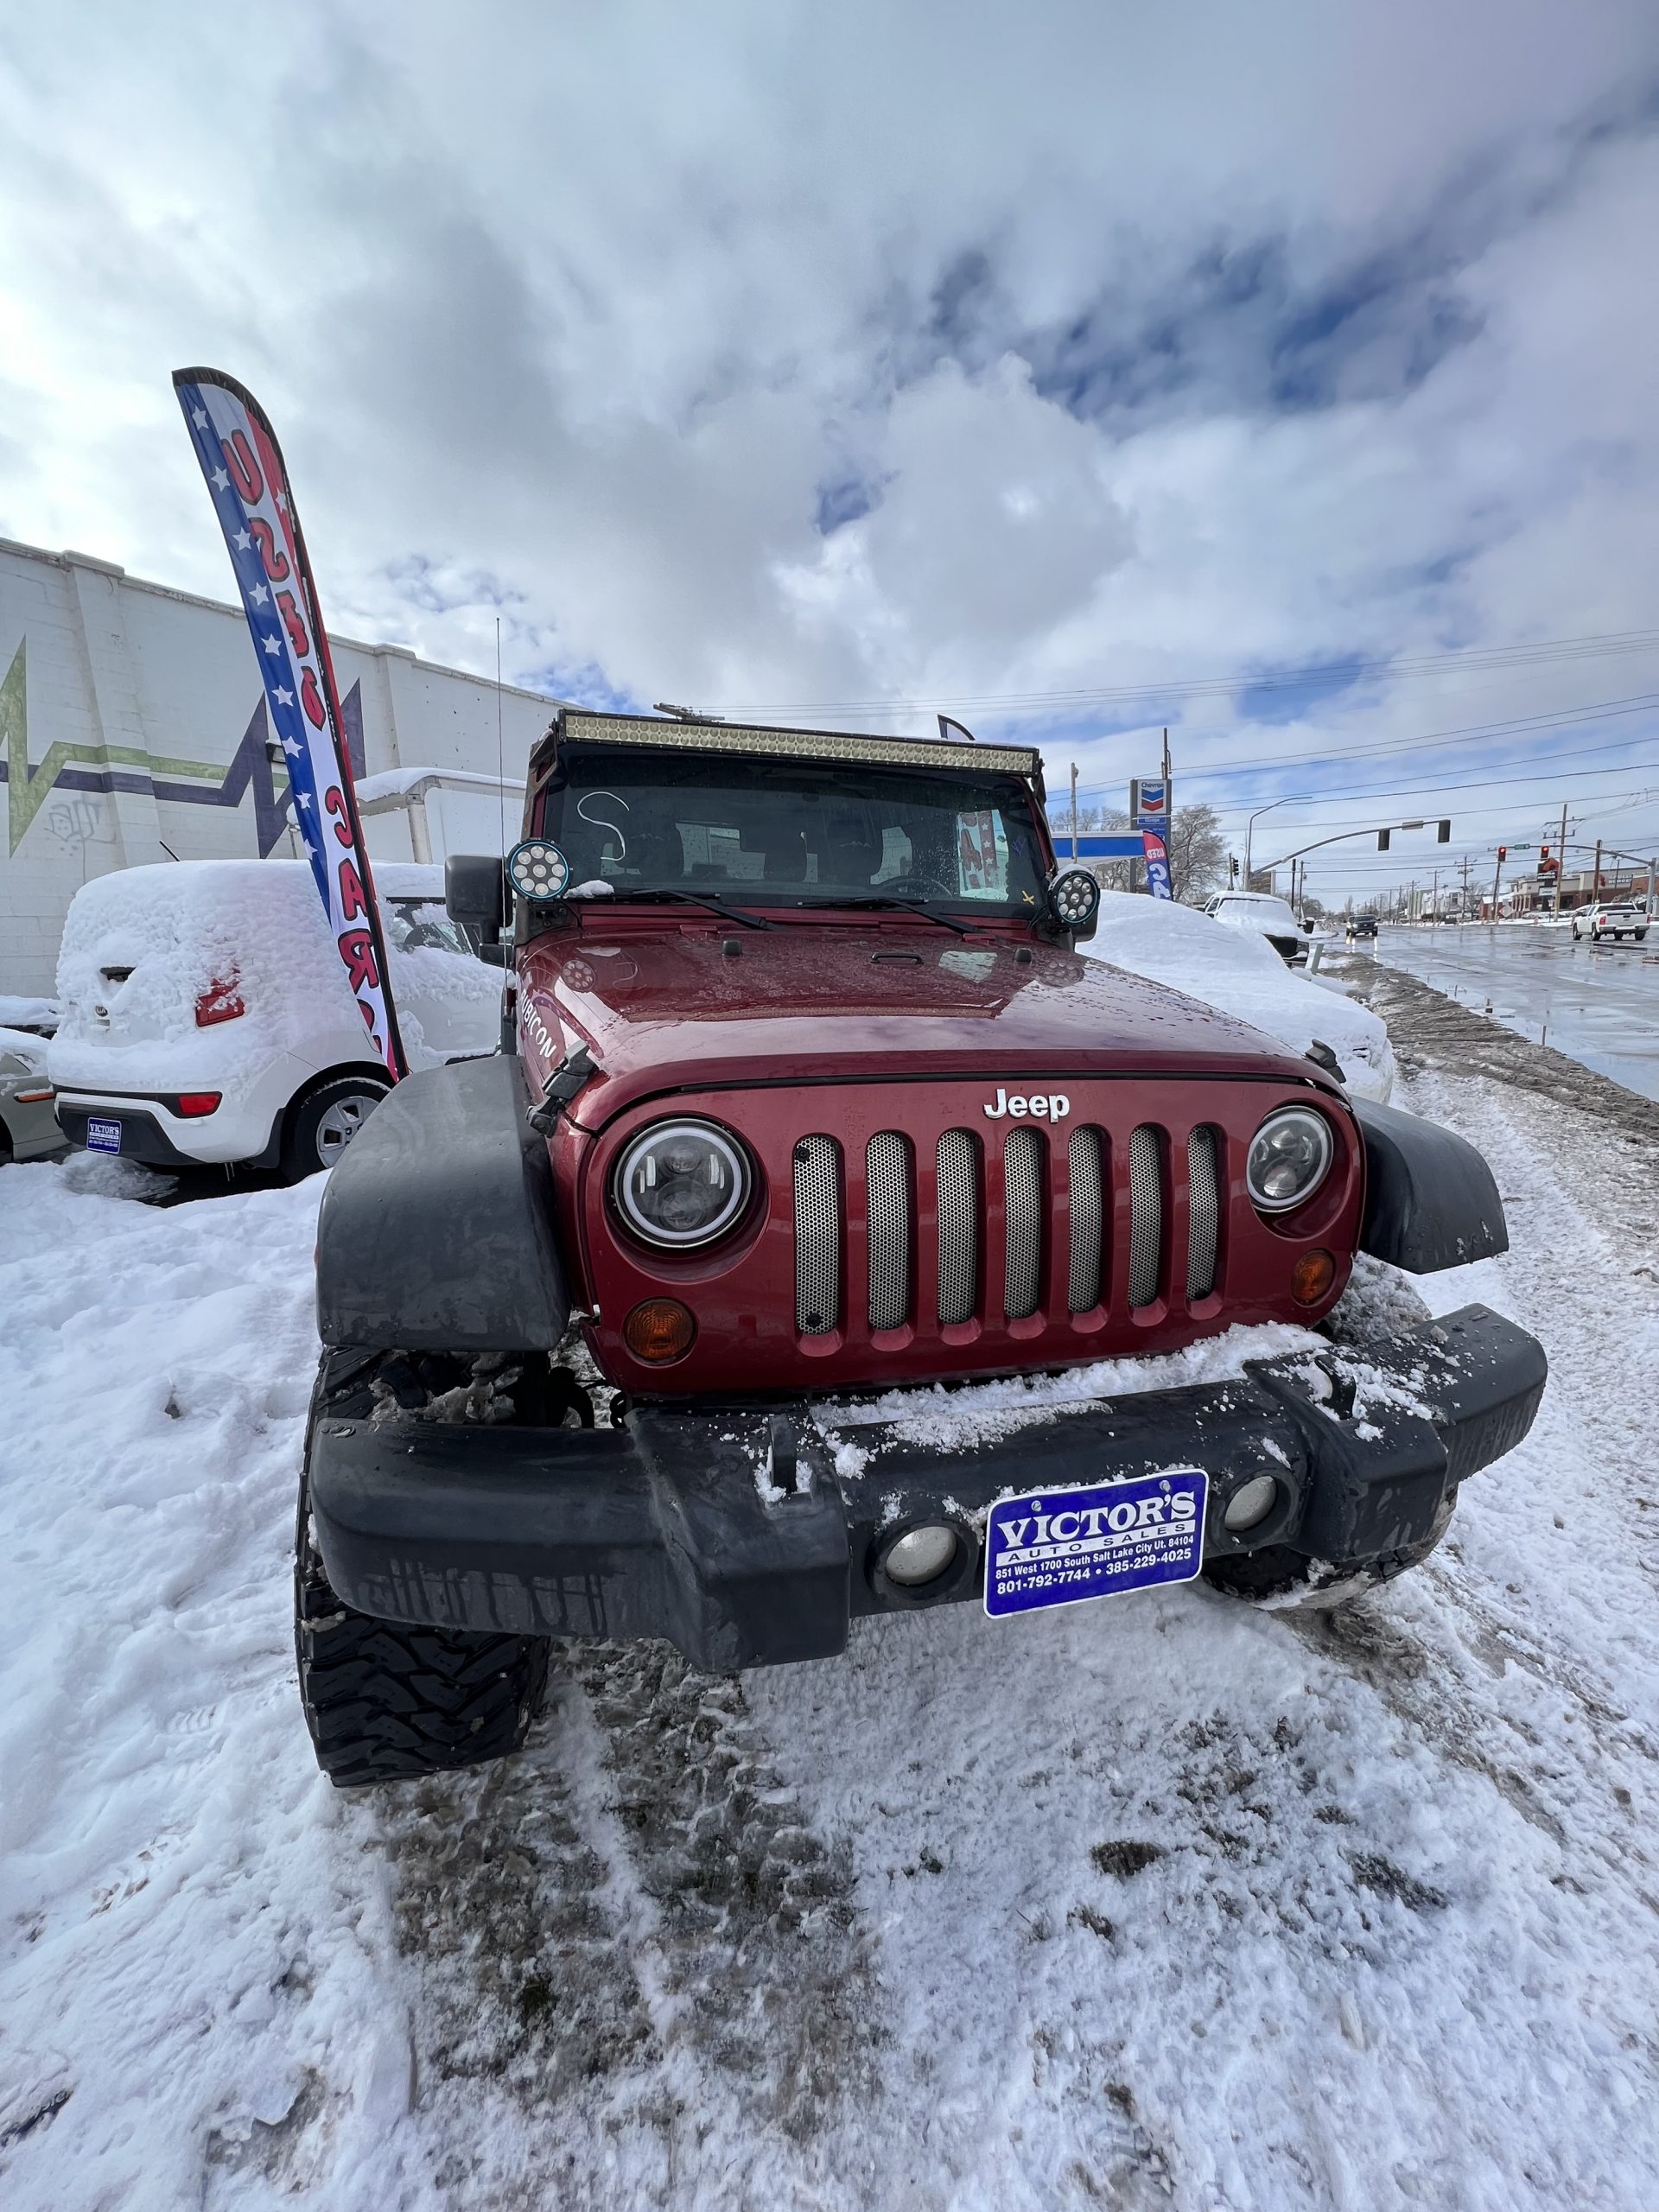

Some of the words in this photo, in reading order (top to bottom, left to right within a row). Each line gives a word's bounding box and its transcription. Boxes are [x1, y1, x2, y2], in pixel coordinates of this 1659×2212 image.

[520, 988, 557, 1058] RUBICON
[983, 1088, 1070, 1124] Jeep
[89, 1123, 119, 1135] VICTOR'S
[996, 1491, 1196, 1548] VICTOR'S
[995, 1567, 1012, 1579] 851
[1014, 1563, 1038, 1575] West
[1040, 1559, 1062, 1571] 1700
[1064, 1554, 1090, 1567] South
[1093, 1550, 1111, 1562] Salt
[1113, 1548, 1134, 1559] Lake
[1135, 1543, 1152, 1554] City
[1154, 1540, 1166, 1550] Ut.
[1168, 1535, 1194, 1547] 84104
[1008, 1543, 1082, 1562] AUTO
[1103, 1523, 1185, 1546] SALES
[997, 1567, 1090, 1594] 801-792-7744
[1106, 1548, 1192, 1575] 385-229-4025
